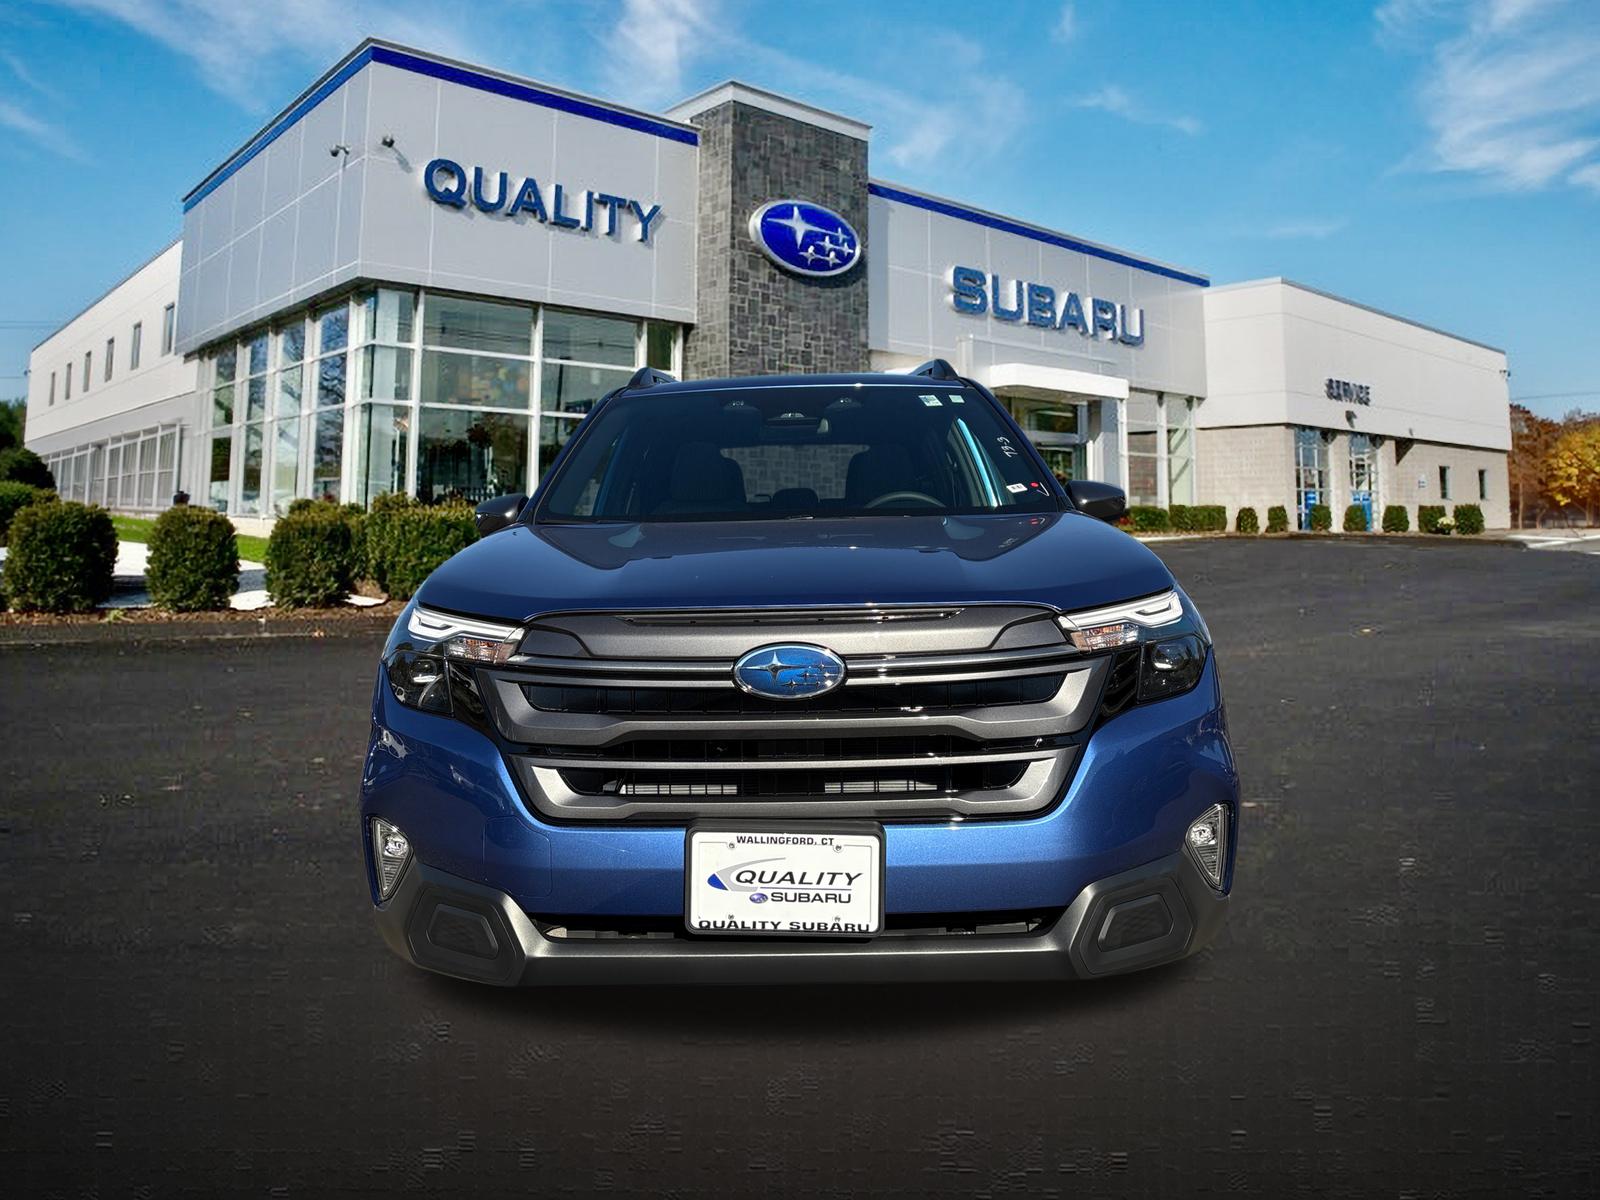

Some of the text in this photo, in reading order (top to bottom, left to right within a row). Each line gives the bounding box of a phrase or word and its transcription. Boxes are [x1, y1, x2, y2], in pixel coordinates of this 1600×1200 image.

[423, 158, 661, 242] QUALITY
[949, 265, 1145, 346] SUBARU
[1325, 378, 1371, 406] SERVICE
[821, 837, 835, 846] CT
[735, 869, 864, 886] QUALITY
[770, 891, 852, 904] SUBARU
[698, 919, 870, 933] QUALITY SUBARU
